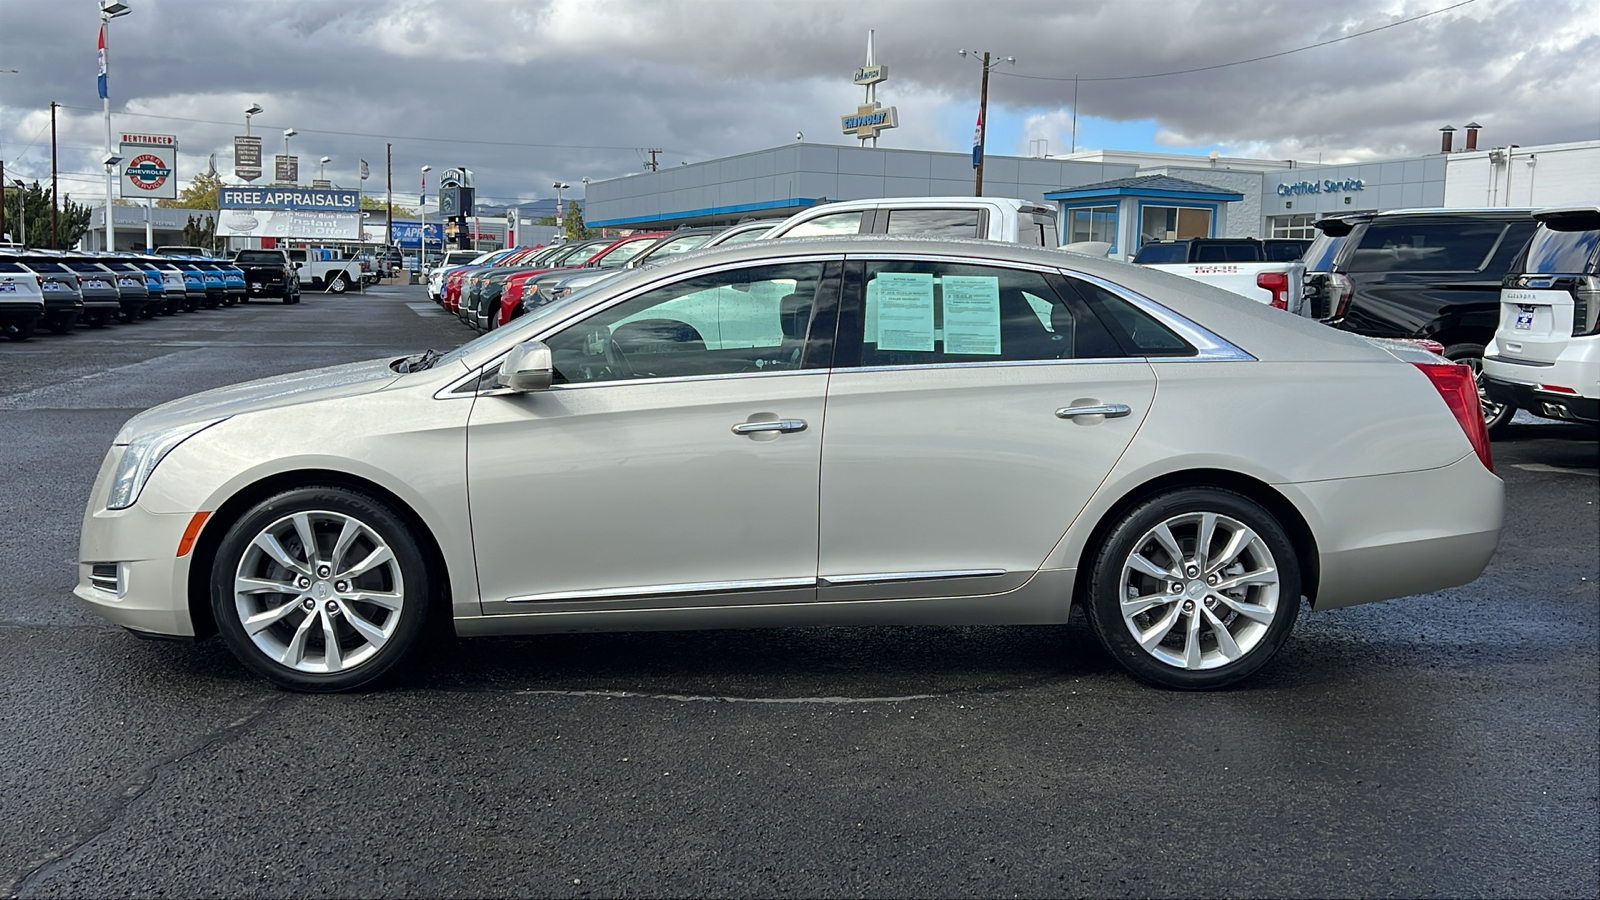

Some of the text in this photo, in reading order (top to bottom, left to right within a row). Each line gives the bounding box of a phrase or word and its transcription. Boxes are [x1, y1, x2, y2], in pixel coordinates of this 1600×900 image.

[844, 112, 887, 129] CHEVROLET
[128, 134, 167, 144] ENTRANCE
[134, 155, 161, 165] SUPER
[127, 168, 168, 176] CHEVROLET
[132, 177, 164, 190] SERVICE
[1277, 178, 1365, 197] Certified Service
[224, 191, 356, 207] FREE APPRAISALS!
[289, 216, 338, 228] Instant
[275, 224, 311, 234] Cash
[315, 226, 350, 236] Offer
